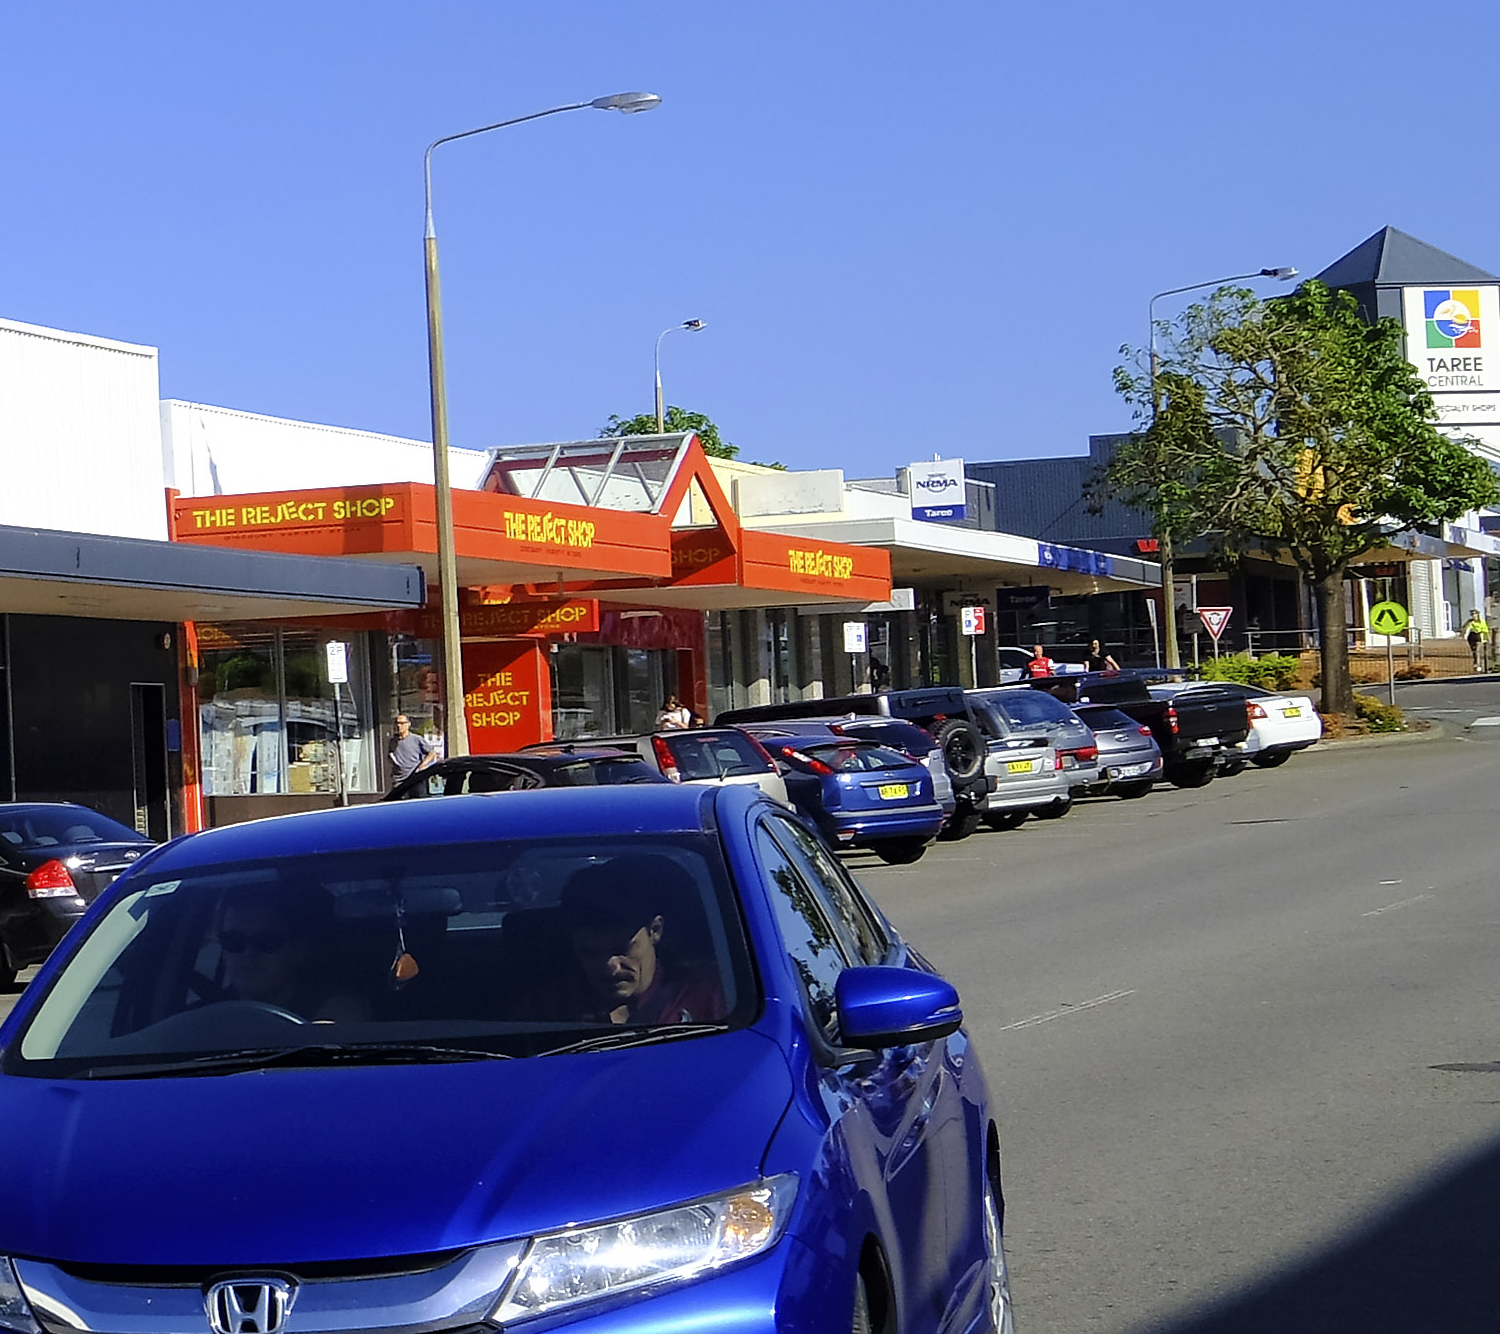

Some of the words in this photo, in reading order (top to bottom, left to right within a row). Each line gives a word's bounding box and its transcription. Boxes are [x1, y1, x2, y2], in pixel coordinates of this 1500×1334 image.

[1427, 357, 1483, 372] TAREE
[1428, 374, 1483, 387] CENTRAL
[916, 479, 959, 490] NRMA
[192, 508, 236, 528] THE
[242, 500, 327, 526] REJECT
[333, 497, 395, 520] SHOP
[925, 508, 953, 517] Taree
[504, 511, 526, 540] THE
[527, 512, 566, 545] REJECT
[568, 519, 595, 547] SHOP
[788, 549, 804, 574] THE
[833, 555, 853, 579] SHOP
[536, 606, 587, 624] SHOP
[478, 672, 512, 687] THE
[463, 689, 530, 708] REJECT
[472, 712, 521, 728] SHOP
